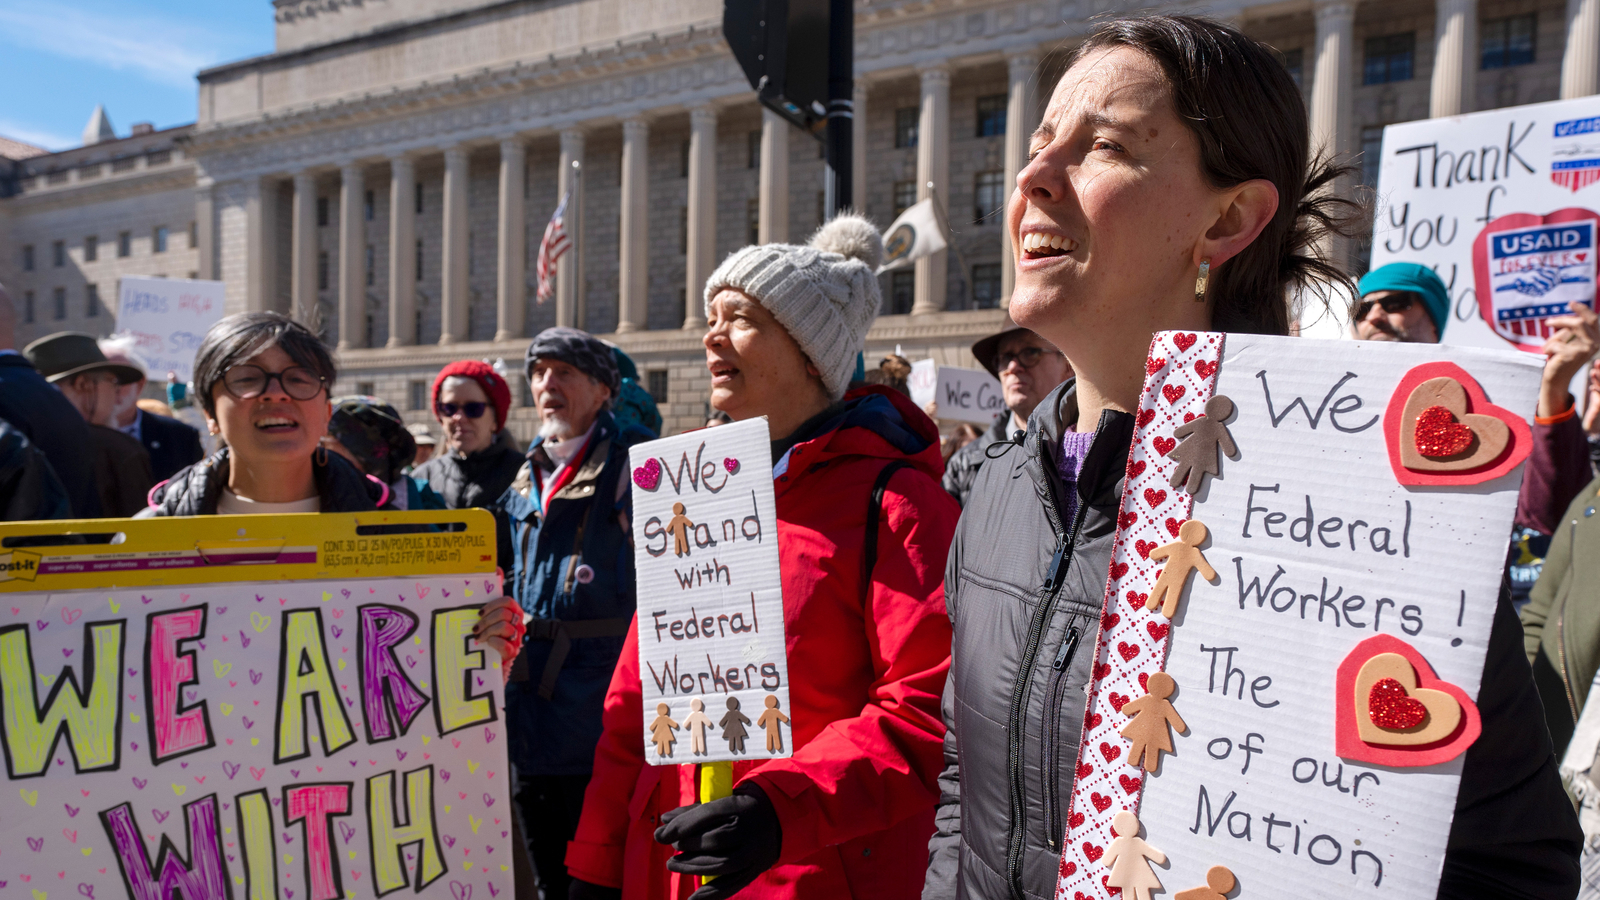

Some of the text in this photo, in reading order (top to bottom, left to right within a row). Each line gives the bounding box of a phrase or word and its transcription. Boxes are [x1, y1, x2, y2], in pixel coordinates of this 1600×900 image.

[1395, 121, 1536, 188] Thank
[1501, 229, 1581, 255] USAID
[945, 380, 971, 409] We
[1256, 370, 1379, 433] We
[660, 440, 728, 495] We
[346, 539, 355, 552] 30
[371, 539, 380, 551] 25
[644, 489, 761, 557] Sand
[1242, 484, 1411, 557] Federal
[0, 559, 35, 571] ost-it
[479, 554, 492, 562] 3M
[675, 558, 731, 590] with
[652, 591, 759, 642] Federal
[1232, 556, 1423, 636] Workers
[0, 603, 498, 780] WE ARE
[647, 654, 780, 695] Workers
[1200, 644, 1280, 708] The
[1207, 732, 1380, 797] of our
[99, 765, 448, 900] WITH
[1189, 784, 1383, 887] Nation
